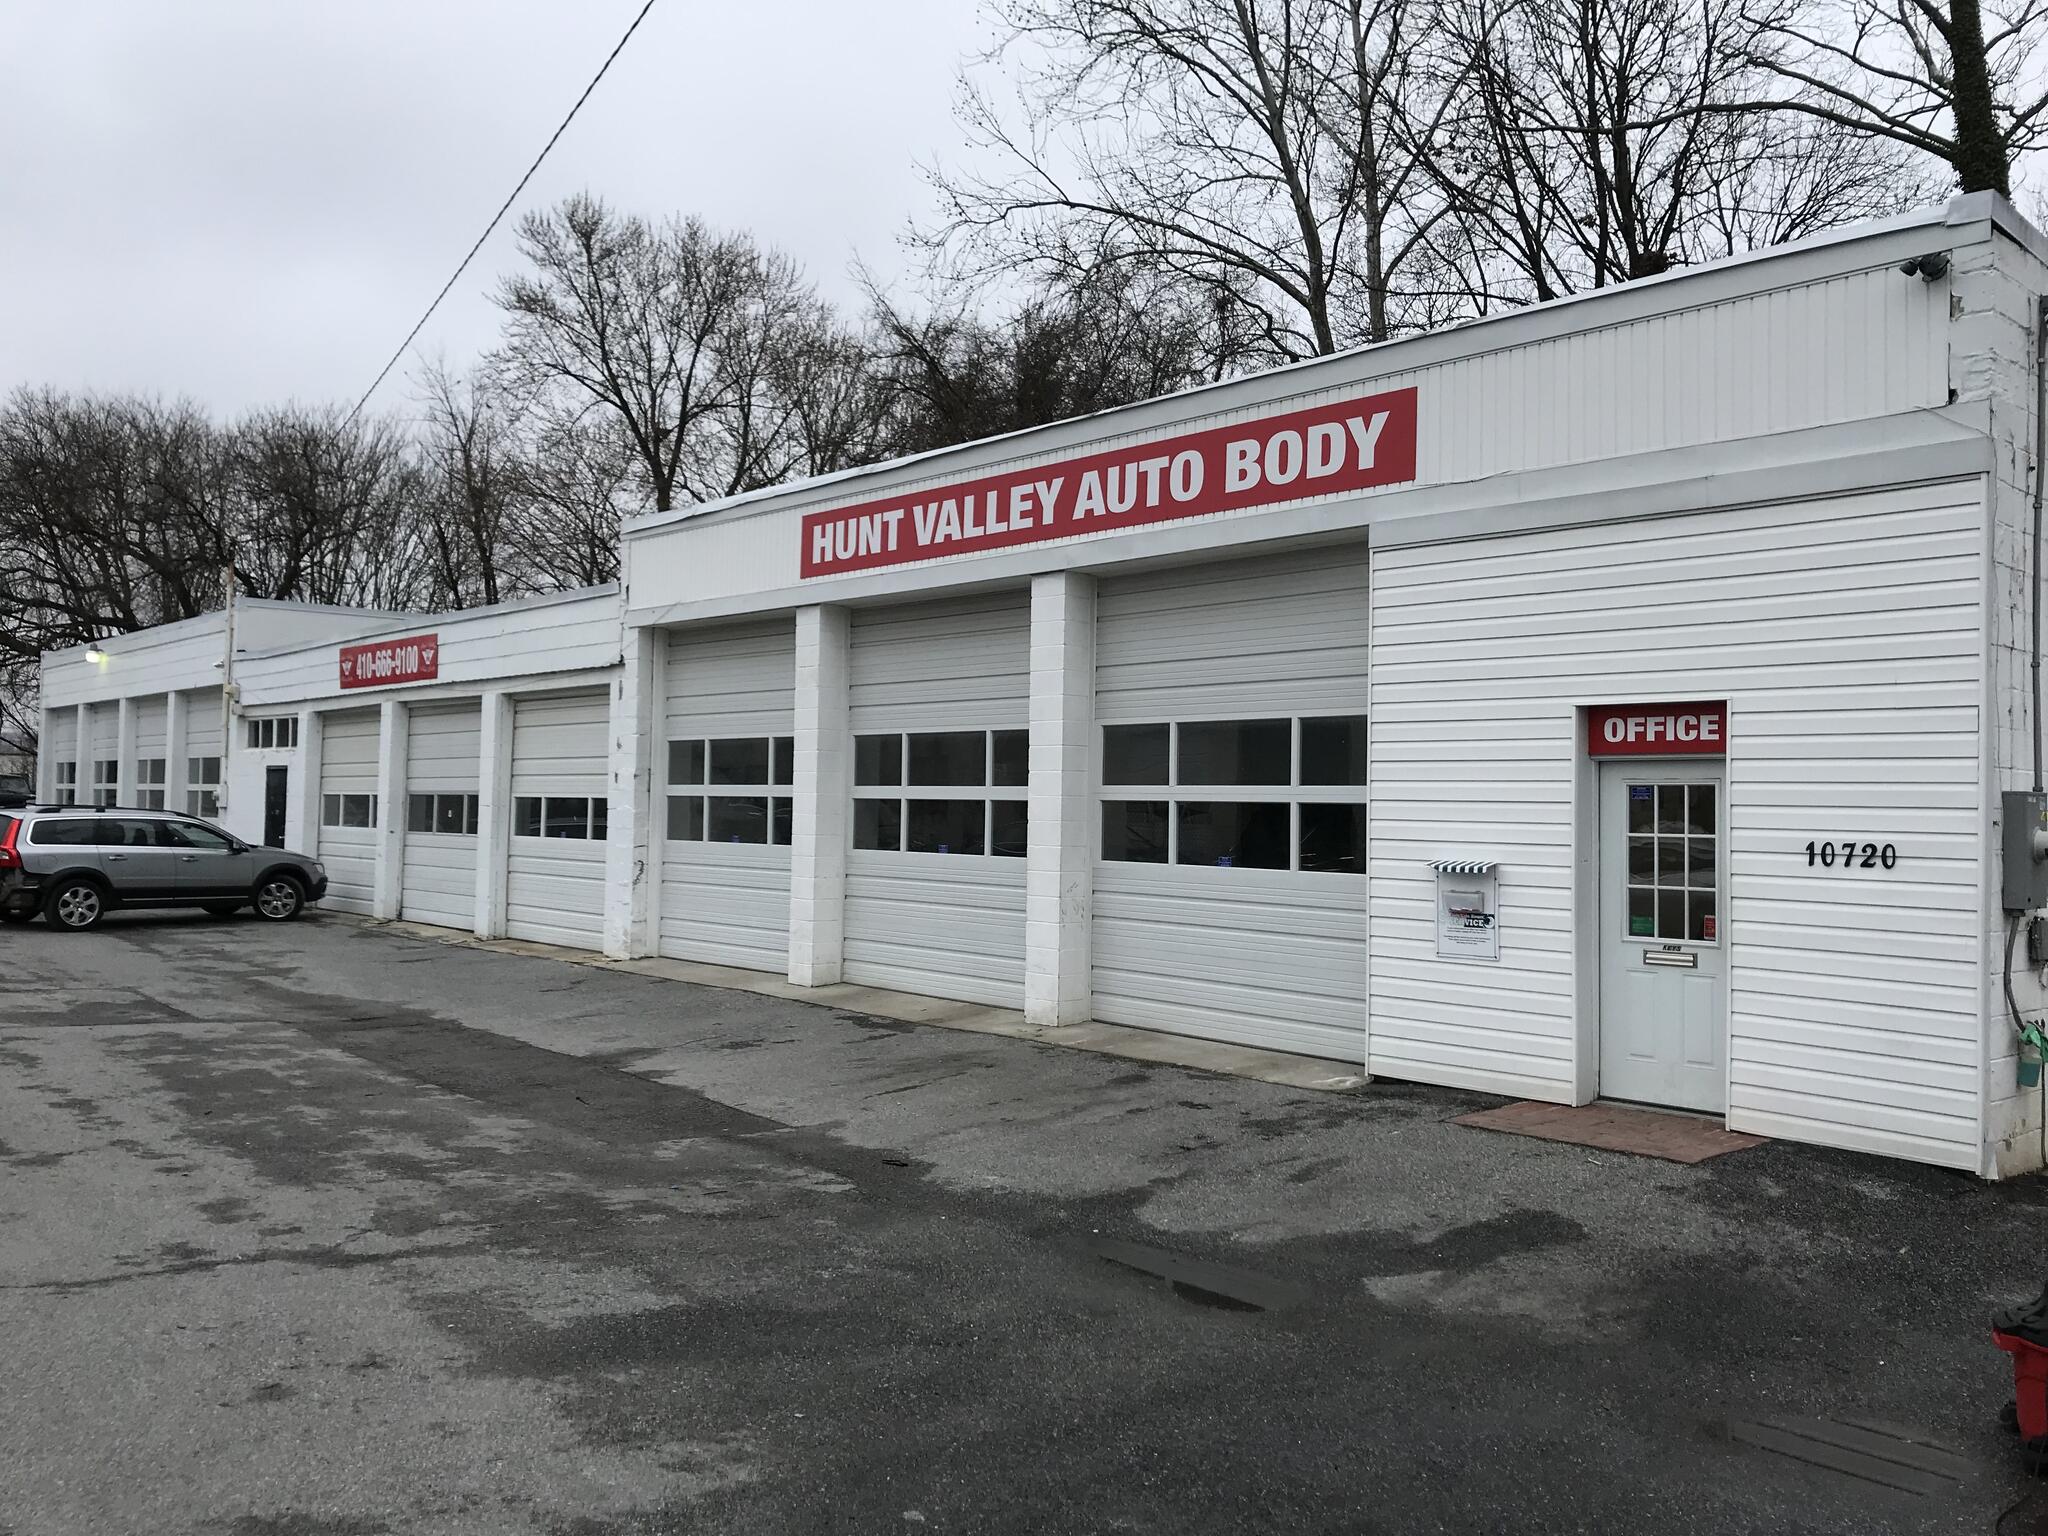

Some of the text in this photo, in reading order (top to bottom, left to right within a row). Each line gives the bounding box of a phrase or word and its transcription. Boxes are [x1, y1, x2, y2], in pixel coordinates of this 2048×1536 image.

[812, 411, 1390, 564] HUNT VALLEY AUTO BODY
[356, 645, 418, 679] 410-666-9100
[1604, 715, 1719, 742] OFFICE
[1805, 841, 1896, 869] 10720
